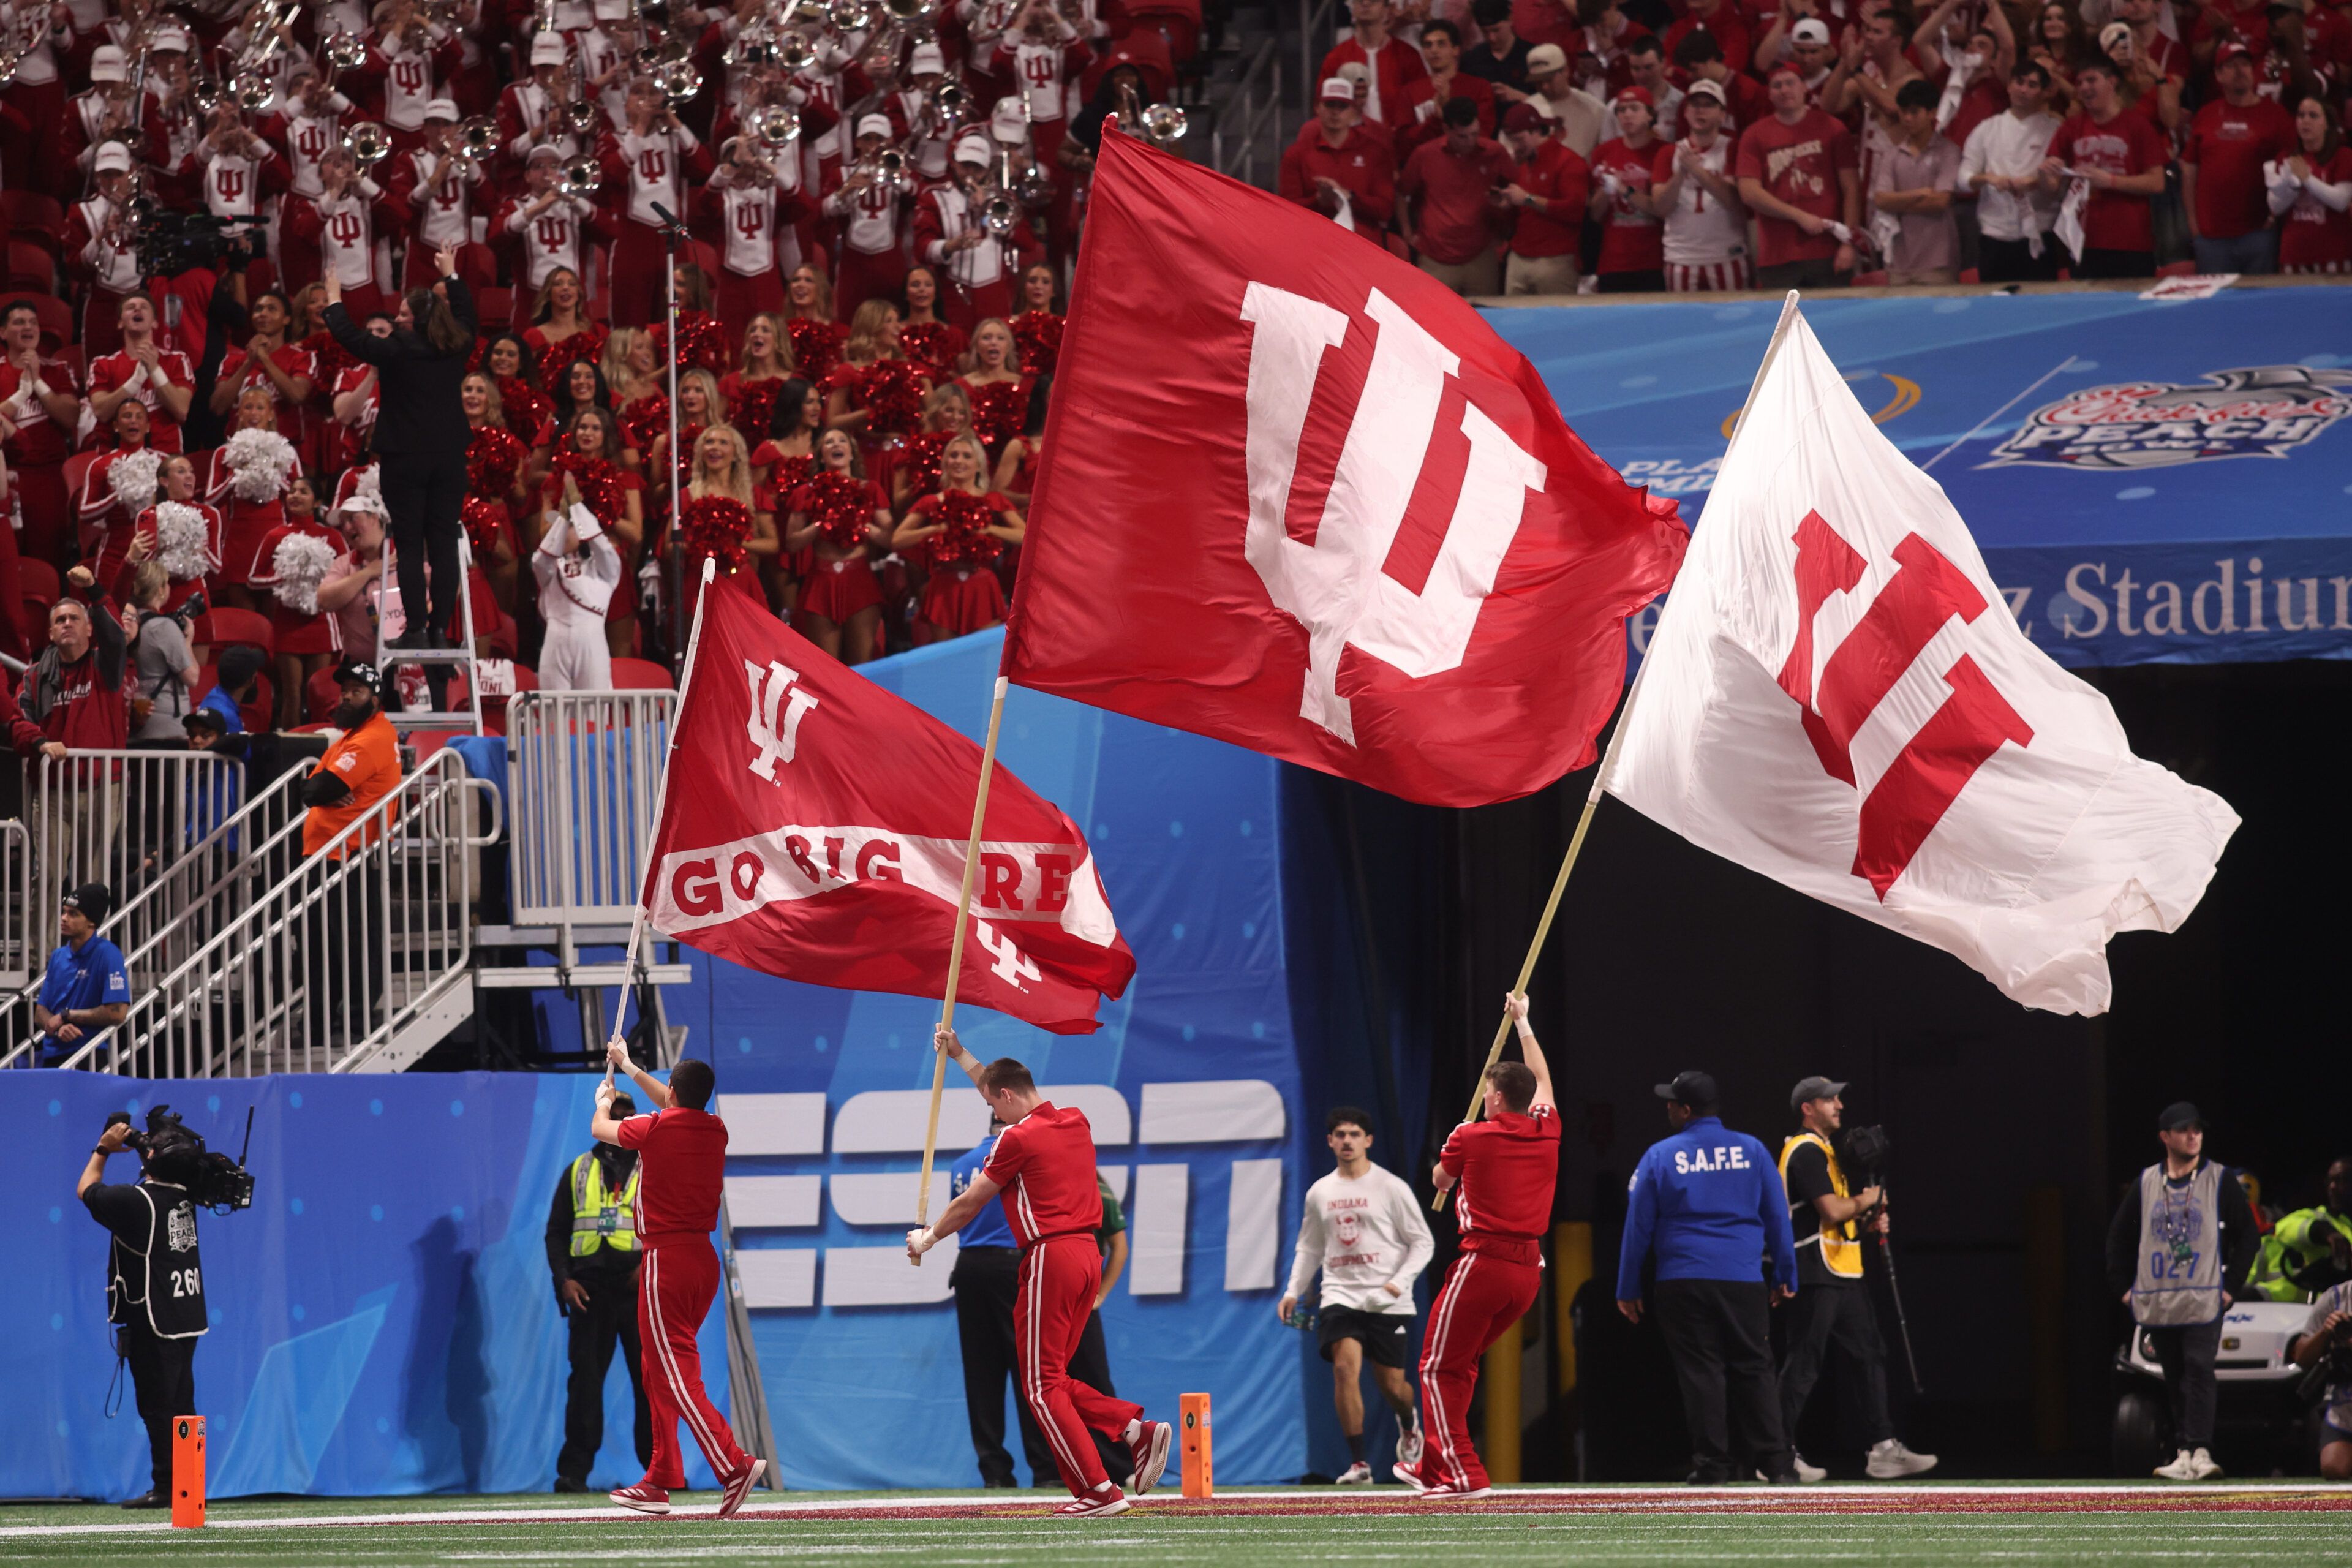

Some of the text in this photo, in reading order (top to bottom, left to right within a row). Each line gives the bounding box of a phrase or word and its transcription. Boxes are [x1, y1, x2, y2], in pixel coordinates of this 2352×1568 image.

[2011, 418, 2321, 450] PEACH
[2058, 439, 2234, 455] BOWL
[671, 834, 1112, 917] GO BIG RE
[1675, 1145, 1751, 1175] S.A.F.E.
[1327, 1197, 1368, 1211] INDIANA
